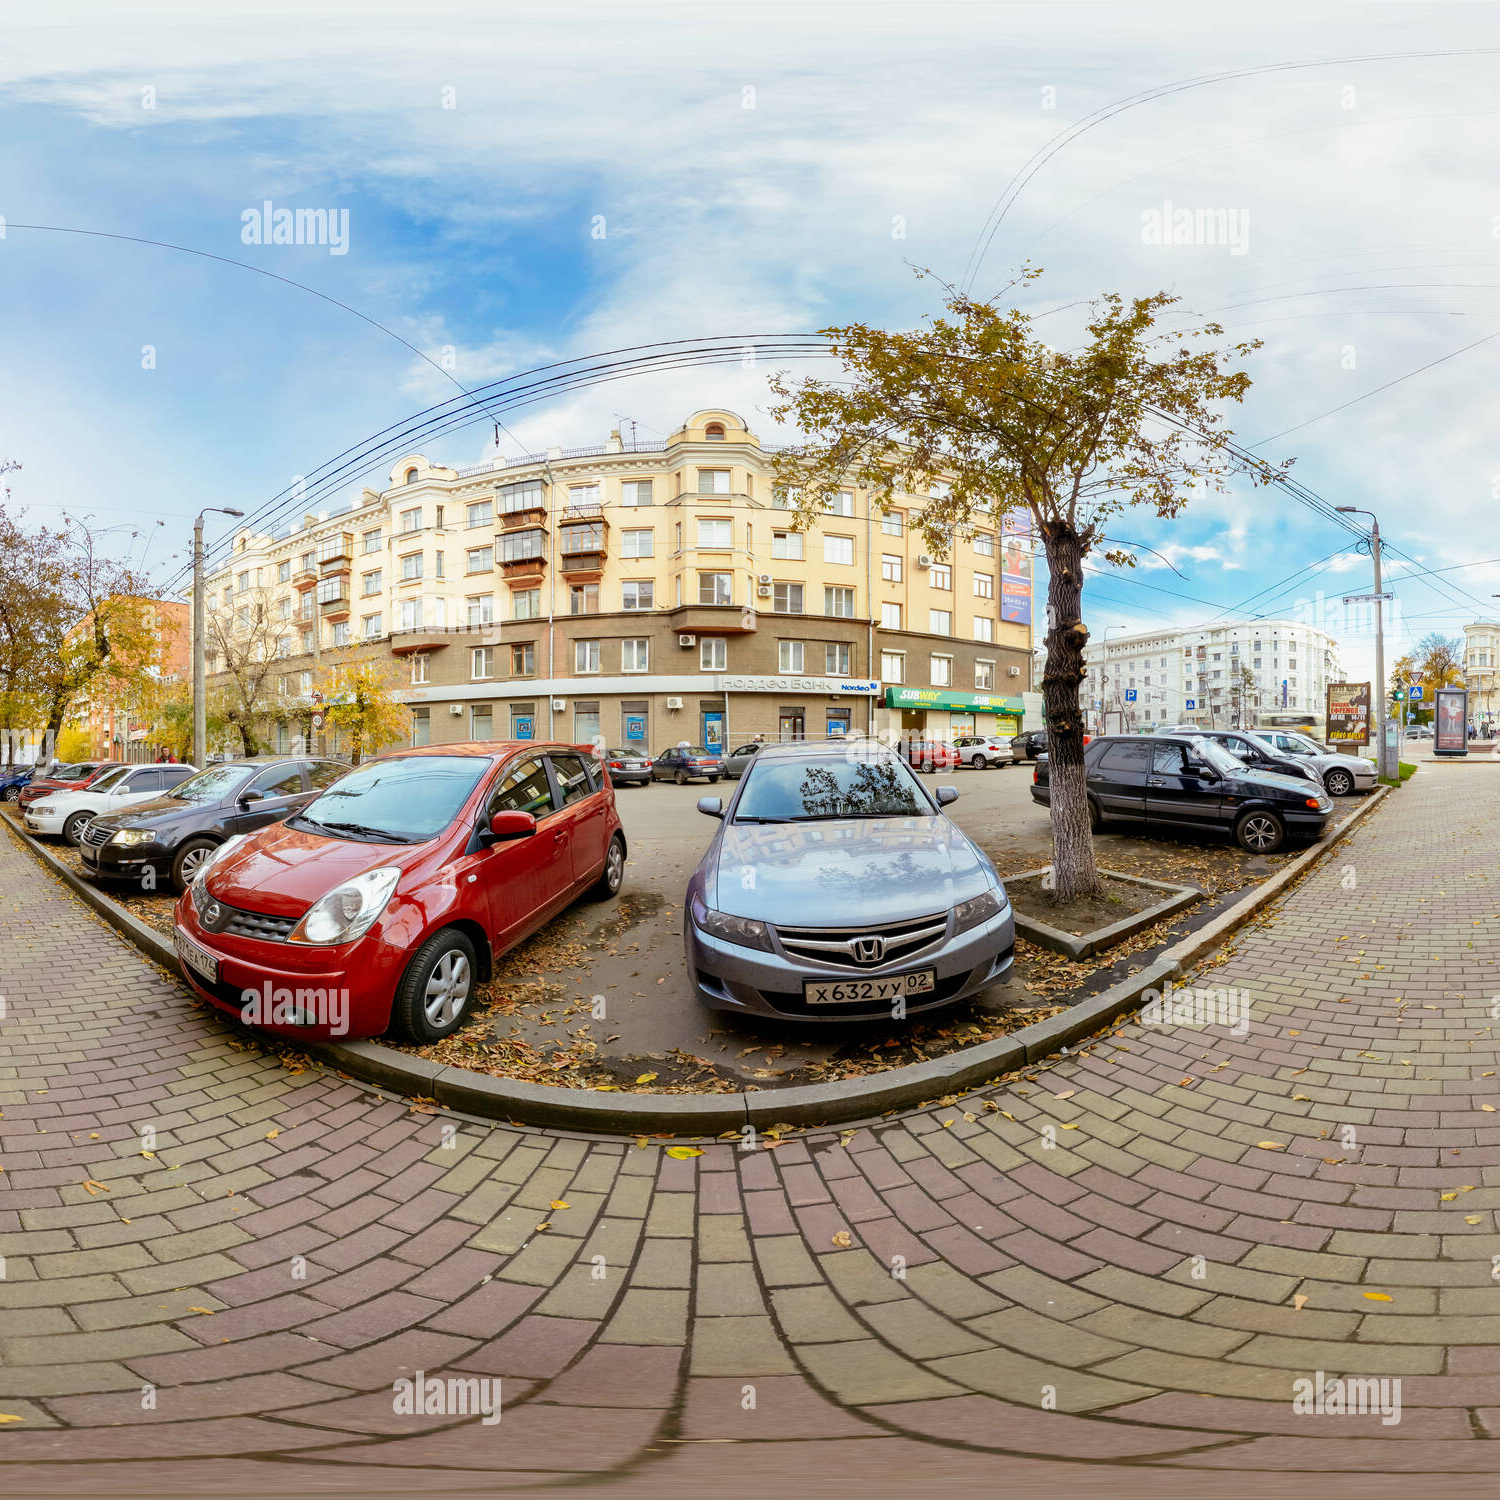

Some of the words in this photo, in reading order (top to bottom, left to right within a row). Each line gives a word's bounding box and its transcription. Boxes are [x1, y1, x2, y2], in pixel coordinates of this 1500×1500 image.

[841, 684, 870, 692] Nordea
[900, 689, 940, 701] SUBWAY
[972, 695, 1006, 706] SUBWAY
[907, 973, 927, 988] 02
